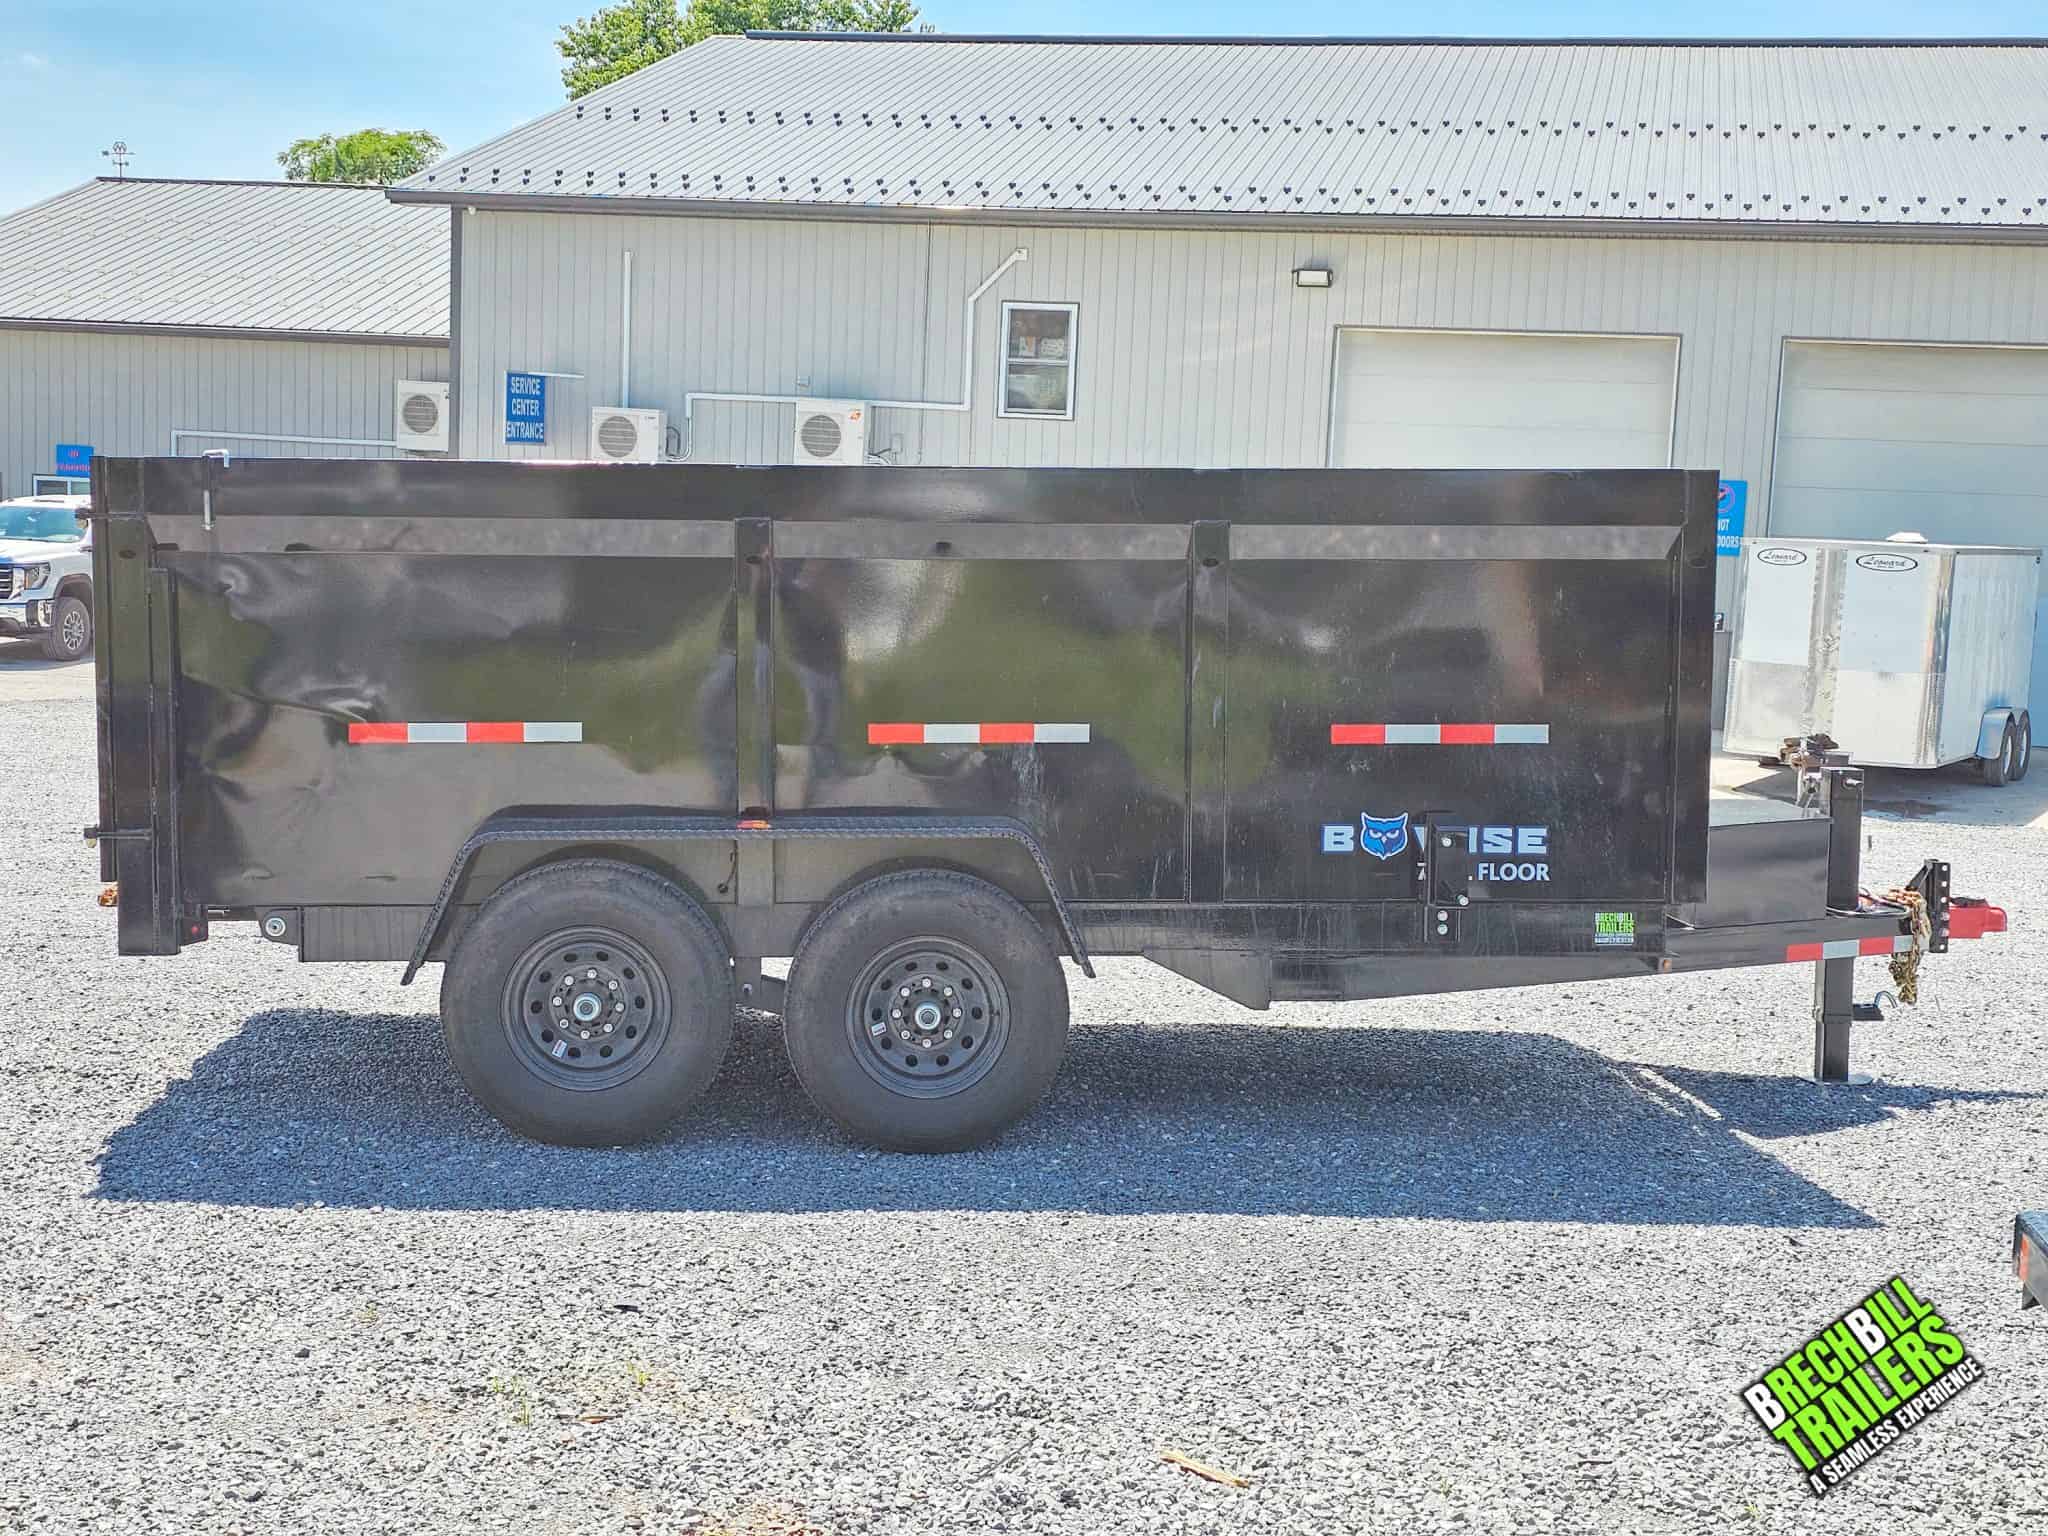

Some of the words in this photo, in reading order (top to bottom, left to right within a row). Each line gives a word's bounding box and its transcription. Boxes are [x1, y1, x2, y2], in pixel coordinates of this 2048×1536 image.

[511, 376, 541, 395] SERVICE
[511, 398, 540, 416] CENTER
[506, 421, 544, 439] ENTRANCE
[1478, 862, 1550, 882] FLOOR
